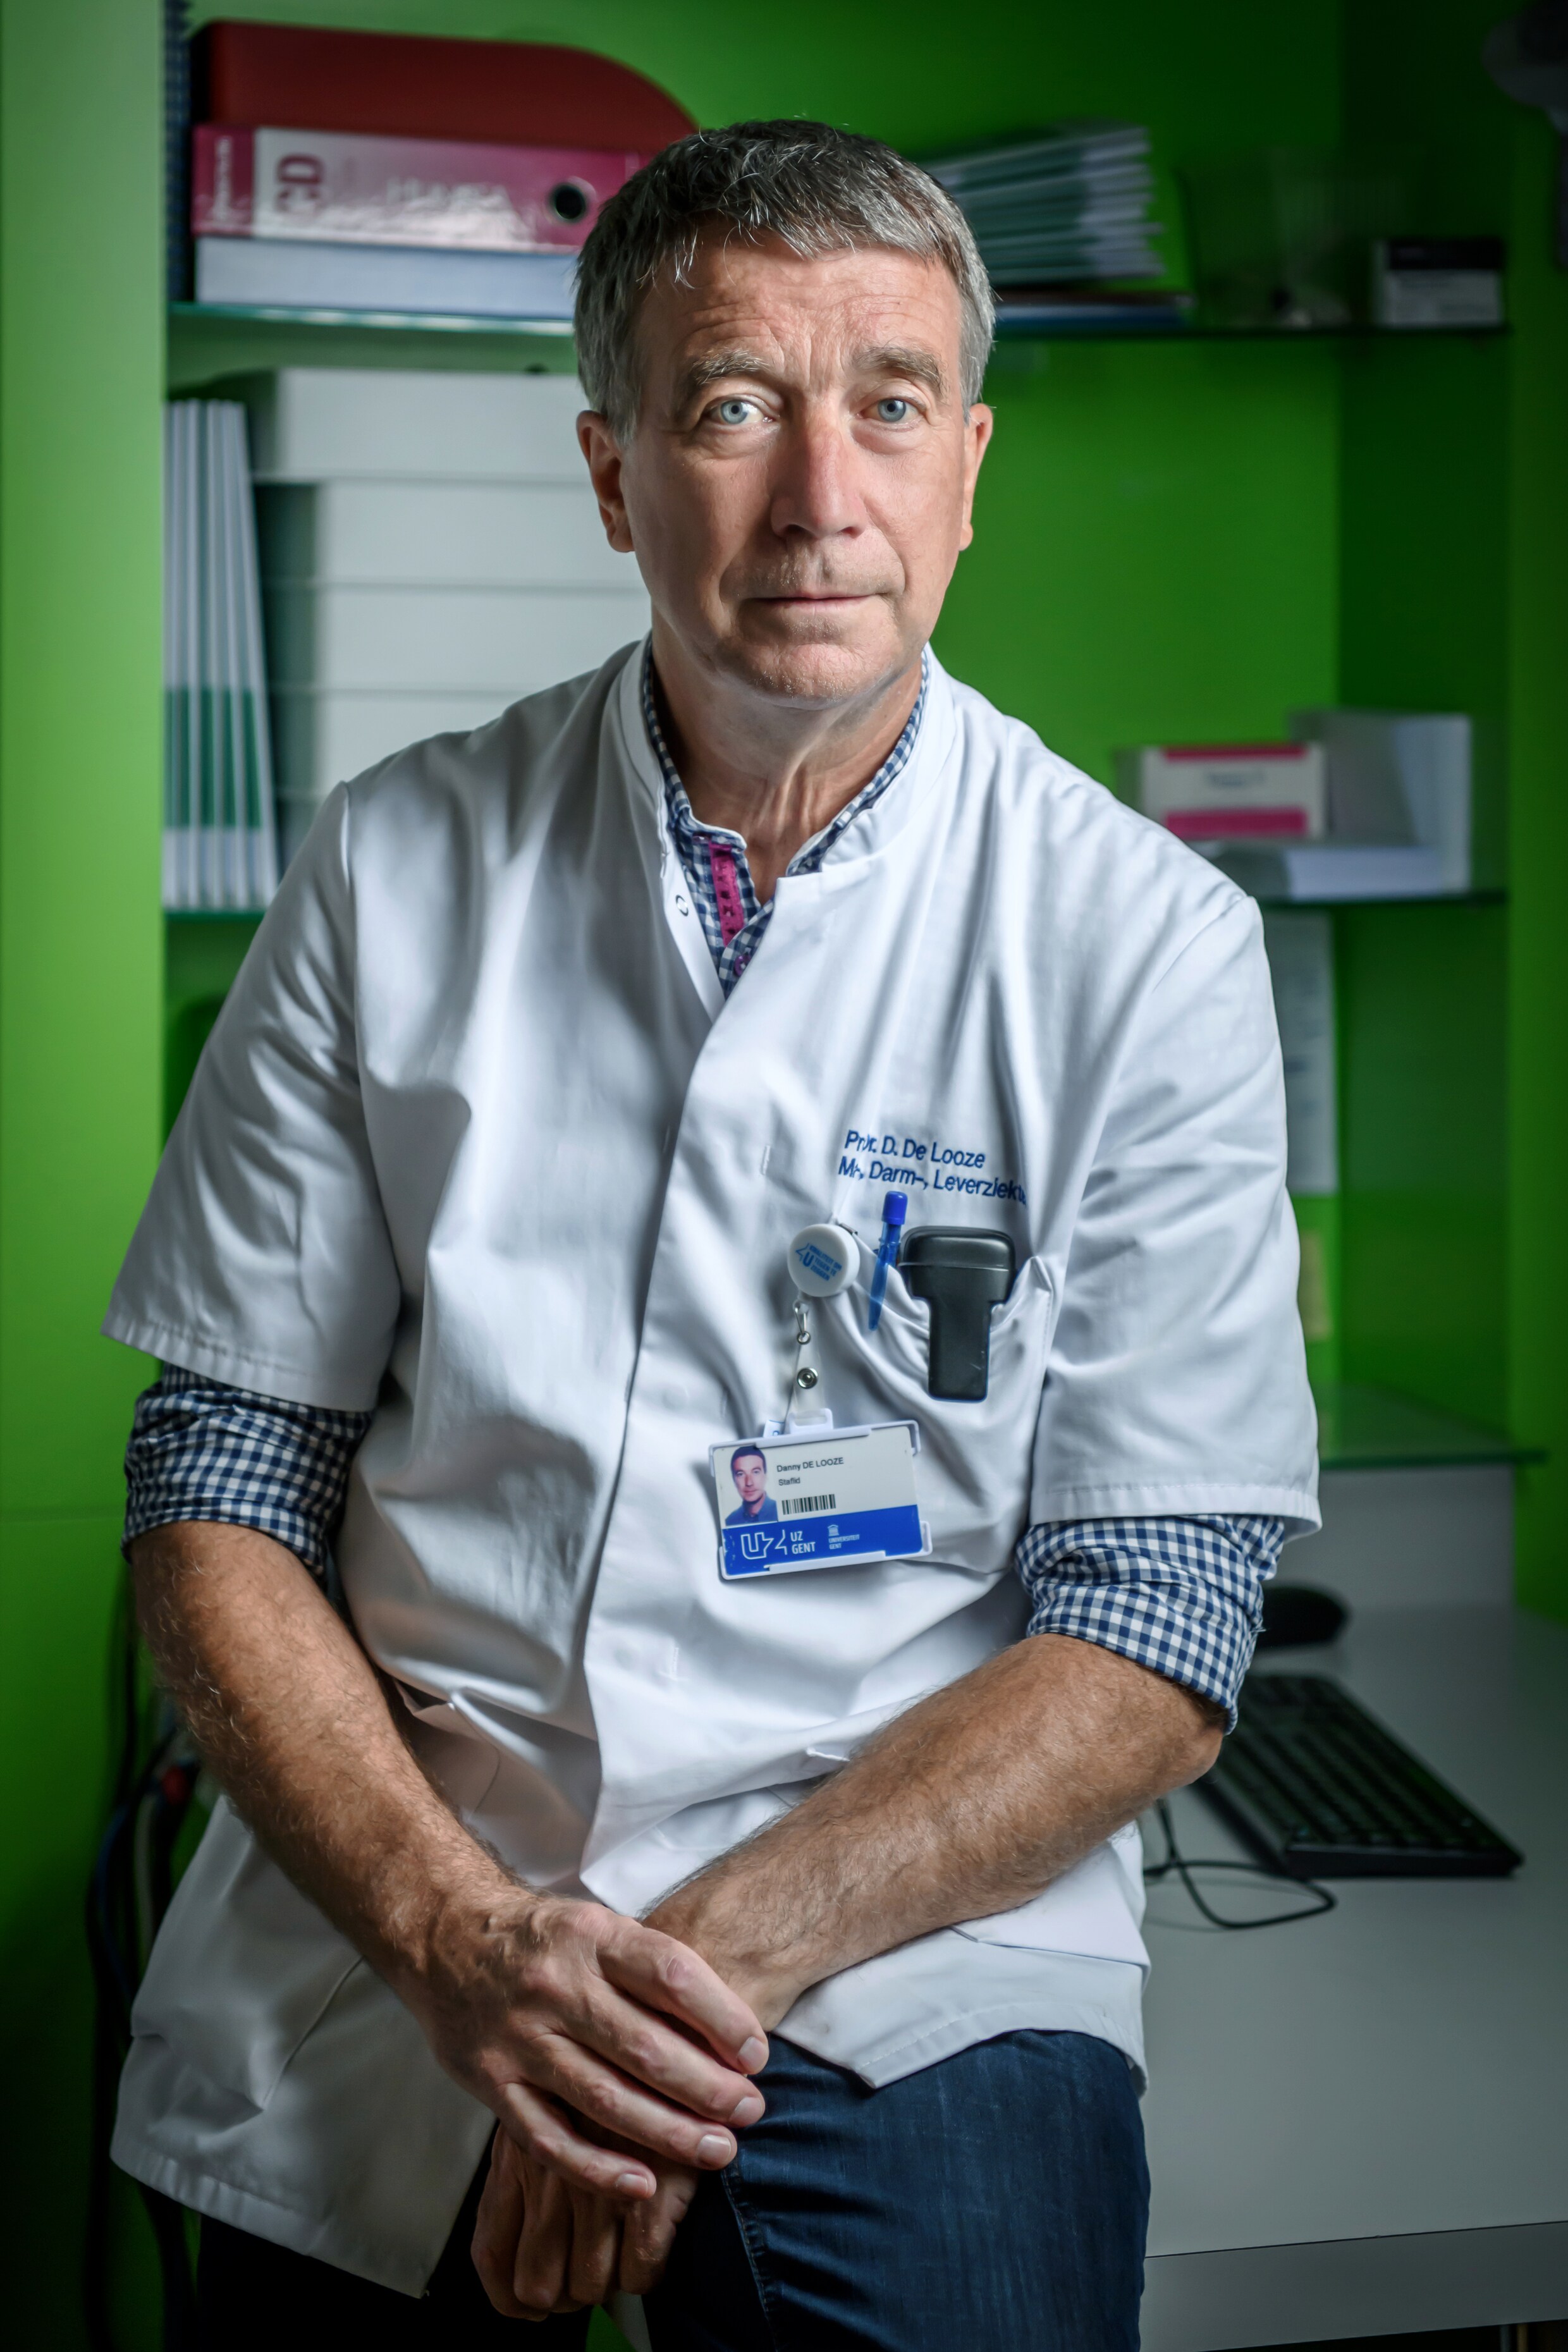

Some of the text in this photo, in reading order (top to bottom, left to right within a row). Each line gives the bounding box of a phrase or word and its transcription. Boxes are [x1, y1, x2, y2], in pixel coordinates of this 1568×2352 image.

[881, 1136, 898, 1156] D.
[902, 1138, 927, 1161] De
[930, 1142, 986, 1169] Looze
[869, 1161, 929, 1191] Darm-,
[776, 1457, 844, 1473] Danny DE LOOZE
[778, 1477, 800, 1486] Staflid
[790, 1531, 803, 1542] UZ
[828, 1534, 860, 1543] UNIVERSITEIT
[792, 1542, 816, 1555] GENT
